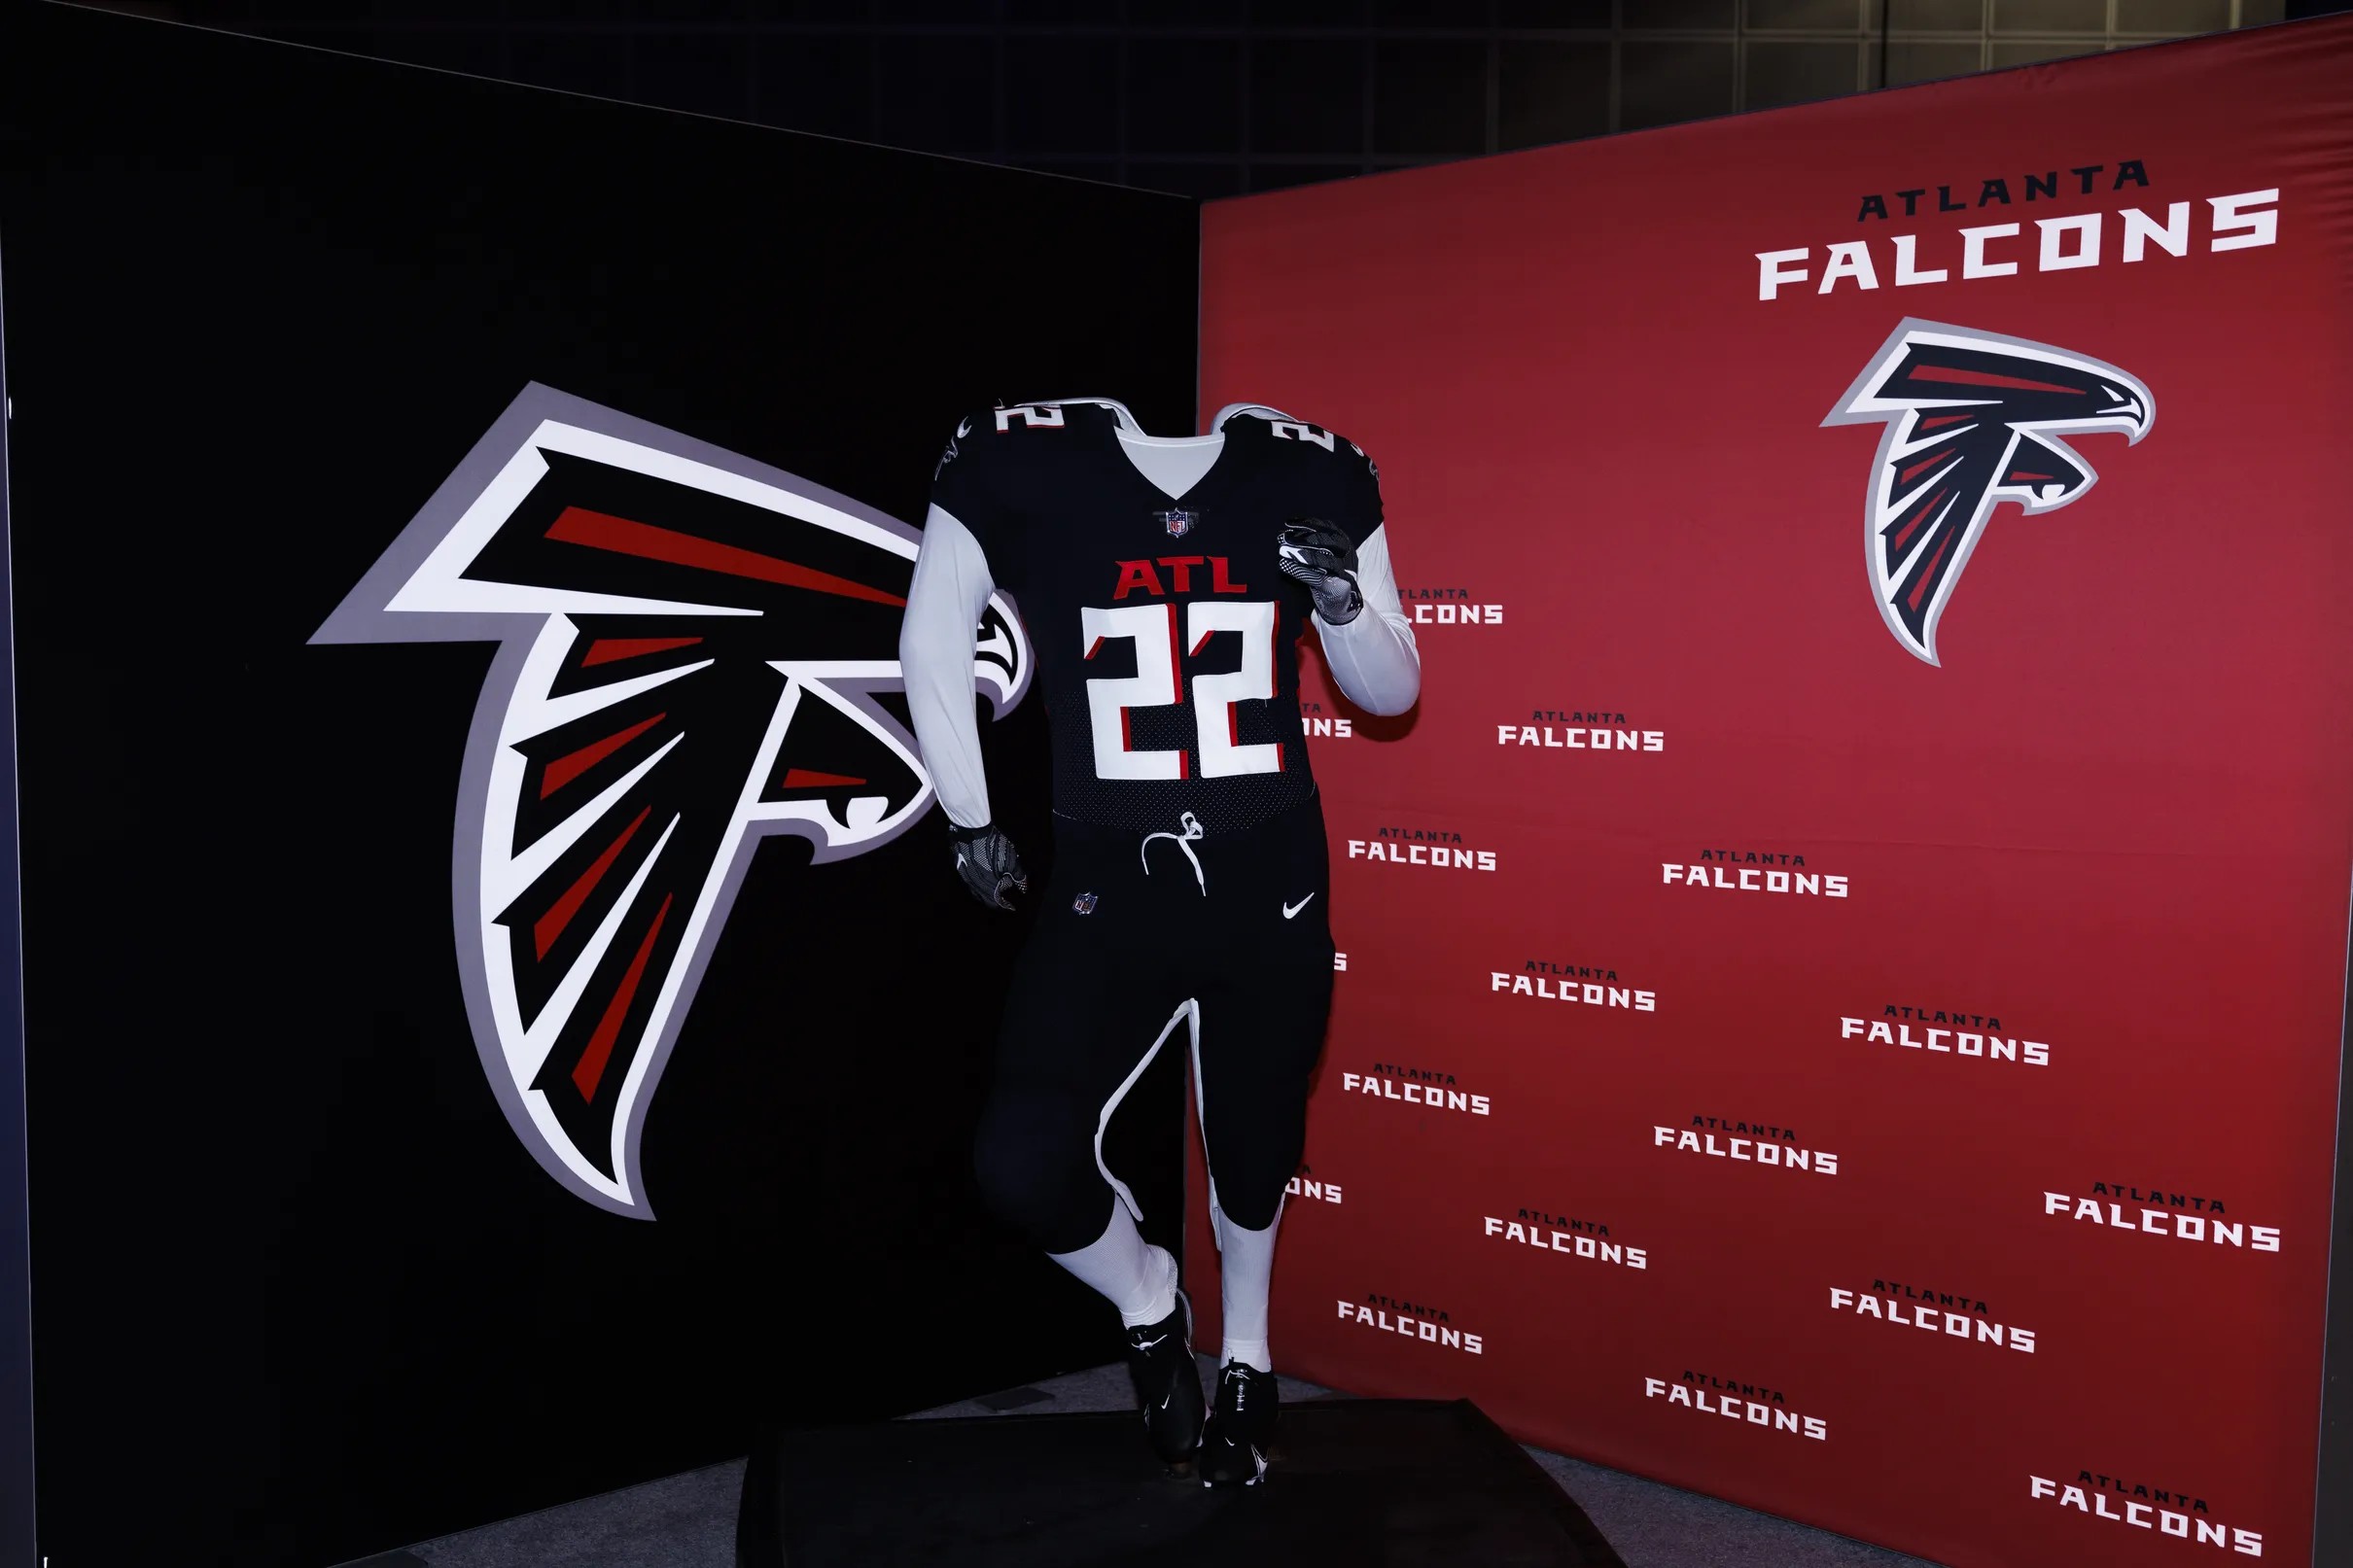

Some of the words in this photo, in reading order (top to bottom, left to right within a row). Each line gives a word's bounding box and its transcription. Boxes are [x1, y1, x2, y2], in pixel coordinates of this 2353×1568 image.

[1857, 159, 2150, 223] ATLANTA
[1755, 188, 2279, 301] FALCONS
[1112, 555, 1247, 599] ATL
[1397, 588, 1468, 600] TLANTA
[1407, 604, 1503, 624] CONS
[1081, 600, 1285, 780] 22
[1532, 711, 1626, 724] ATLANTA
[1497, 725, 1665, 752] FALCONS
[1379, 827, 1462, 844] ATLANTA
[1348, 839, 1496, 872] FALCONS
[1701, 850, 1806, 867] ATLANTA
[1662, 863, 1848, 898] FALCONS
[1526, 960, 1618, 982] ATLANTA
[1491, 972, 1656, 1012] FALCONS
[1884, 1004, 2002, 1031] ATLANTA
[1840, 1017, 2050, 1066] FALCONS
[1374, 1063, 1457, 1086] ATLANTA
[1343, 1072, 1490, 1116] FALCONS
[1693, 1116, 1796, 1142] ATLANTA
[1653, 1126, 1838, 1175] FALCONS
[2093, 1182, 2226, 1214] ATLANTA
[1518, 1208, 1609, 1237] ATLANTA
[2044, 1191, 2281, 1253] FALCONS
[1484, 1216, 1647, 1270] FALCONS
[1368, 1294, 1450, 1323] ATLANTA
[1873, 1279, 1988, 1315] ATLANTA
[1337, 1300, 1483, 1355] FALCONS
[1829, 1287, 2036, 1354] FALCONS
[1683, 1371, 1785, 1405] ATLANTA
[1644, 1376, 1827, 1441] FALCONS
[2078, 1471, 2209, 1514] ATLANTA
[2029, 1475, 2263, 1557] FALCONS
